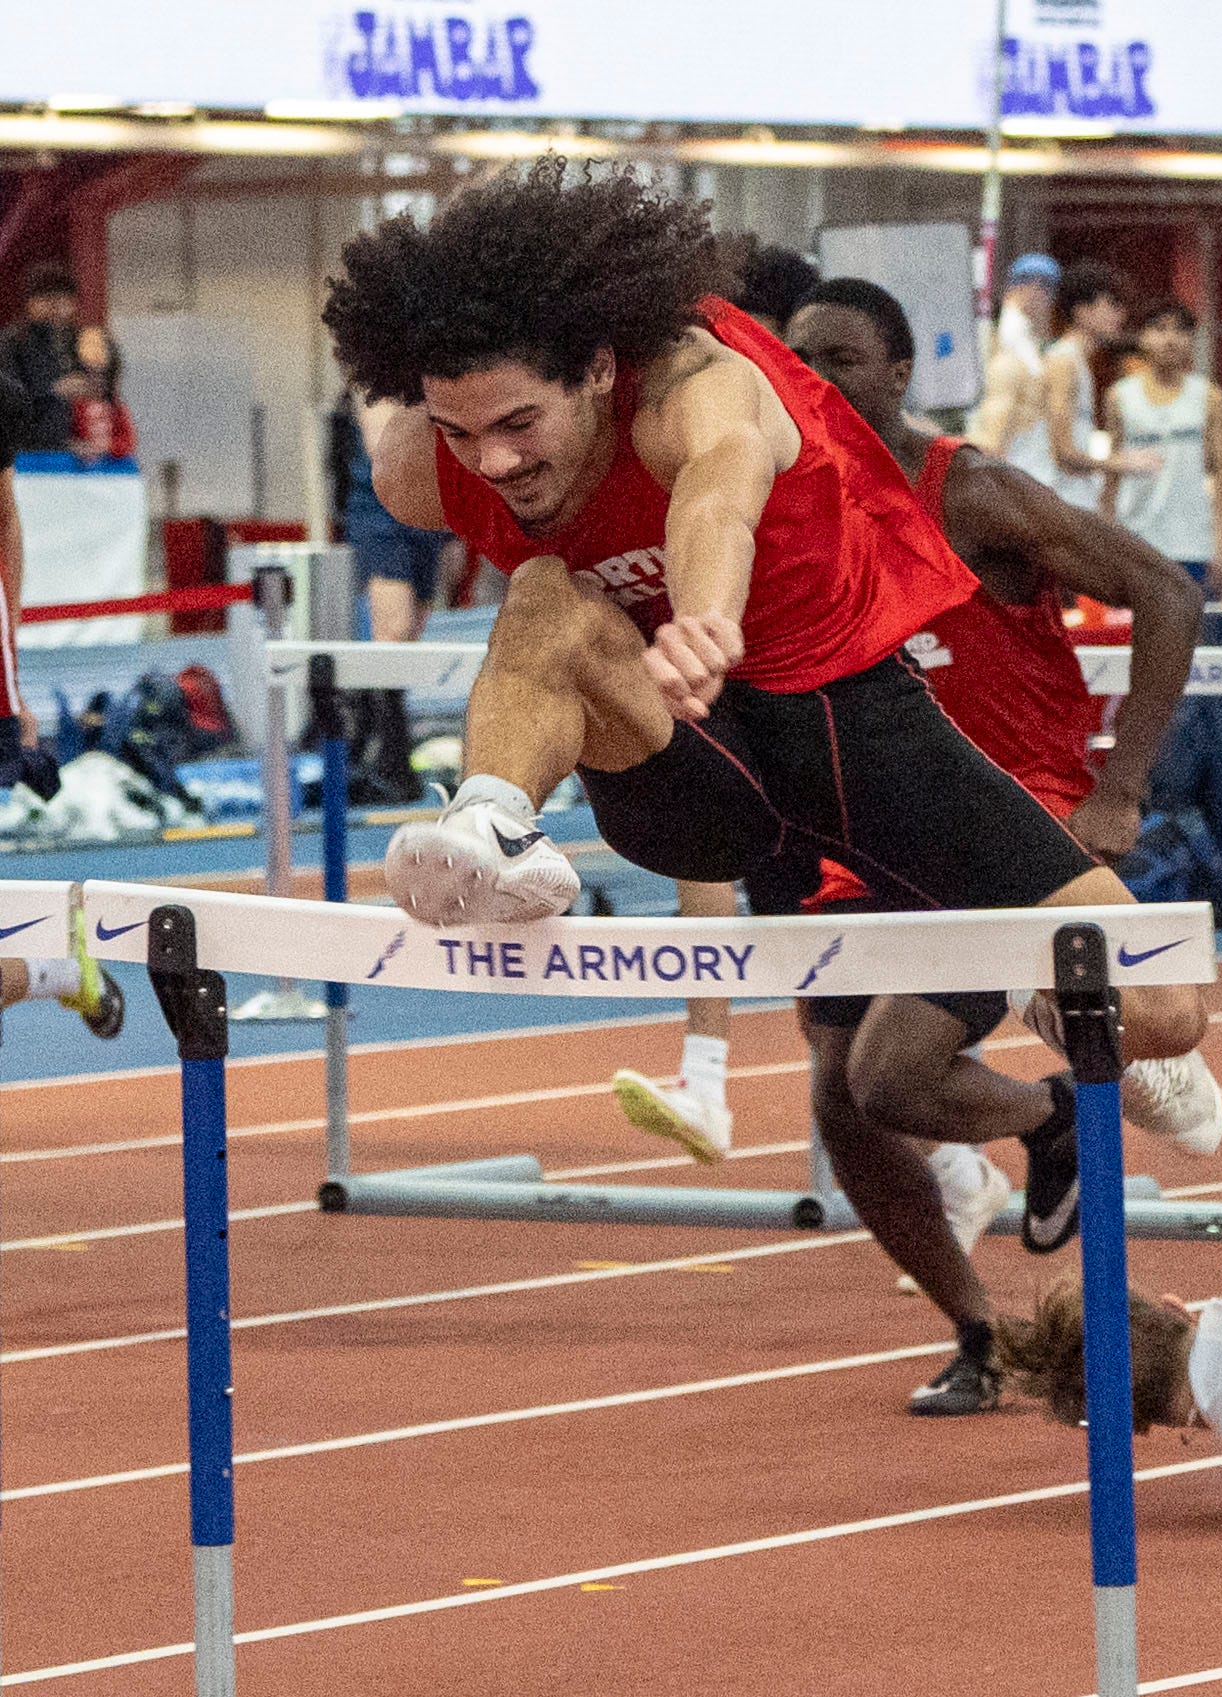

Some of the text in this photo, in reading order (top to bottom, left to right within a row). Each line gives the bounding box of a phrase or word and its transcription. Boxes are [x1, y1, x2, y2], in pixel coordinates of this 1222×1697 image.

[347, 11, 539, 99] JAMBAR
[437, 938, 756, 982] THE ARMORY
